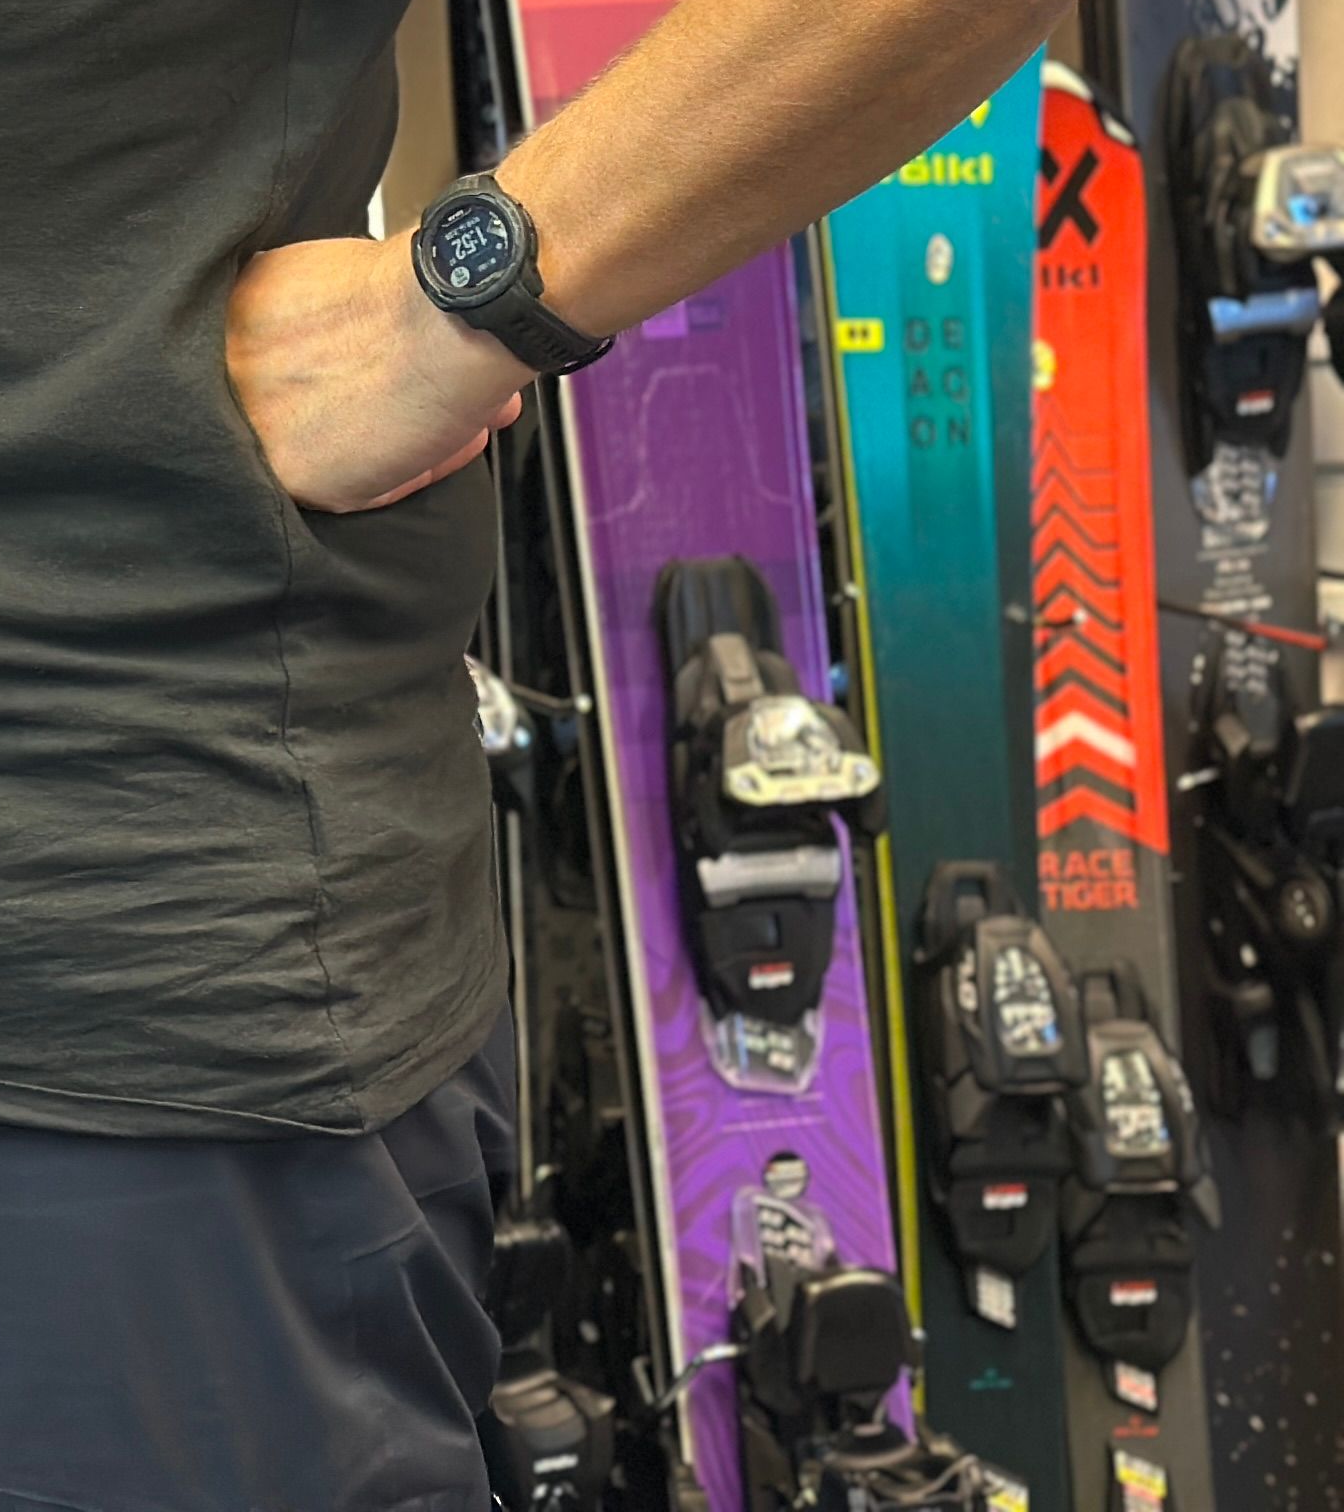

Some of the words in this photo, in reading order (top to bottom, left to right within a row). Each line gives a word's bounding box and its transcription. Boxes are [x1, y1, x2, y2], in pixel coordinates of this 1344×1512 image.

[879, 152, 995, 186] ölkl
[1038, 848, 1134, 881] RACE
[1039, 879, 1139, 912] TIGER
